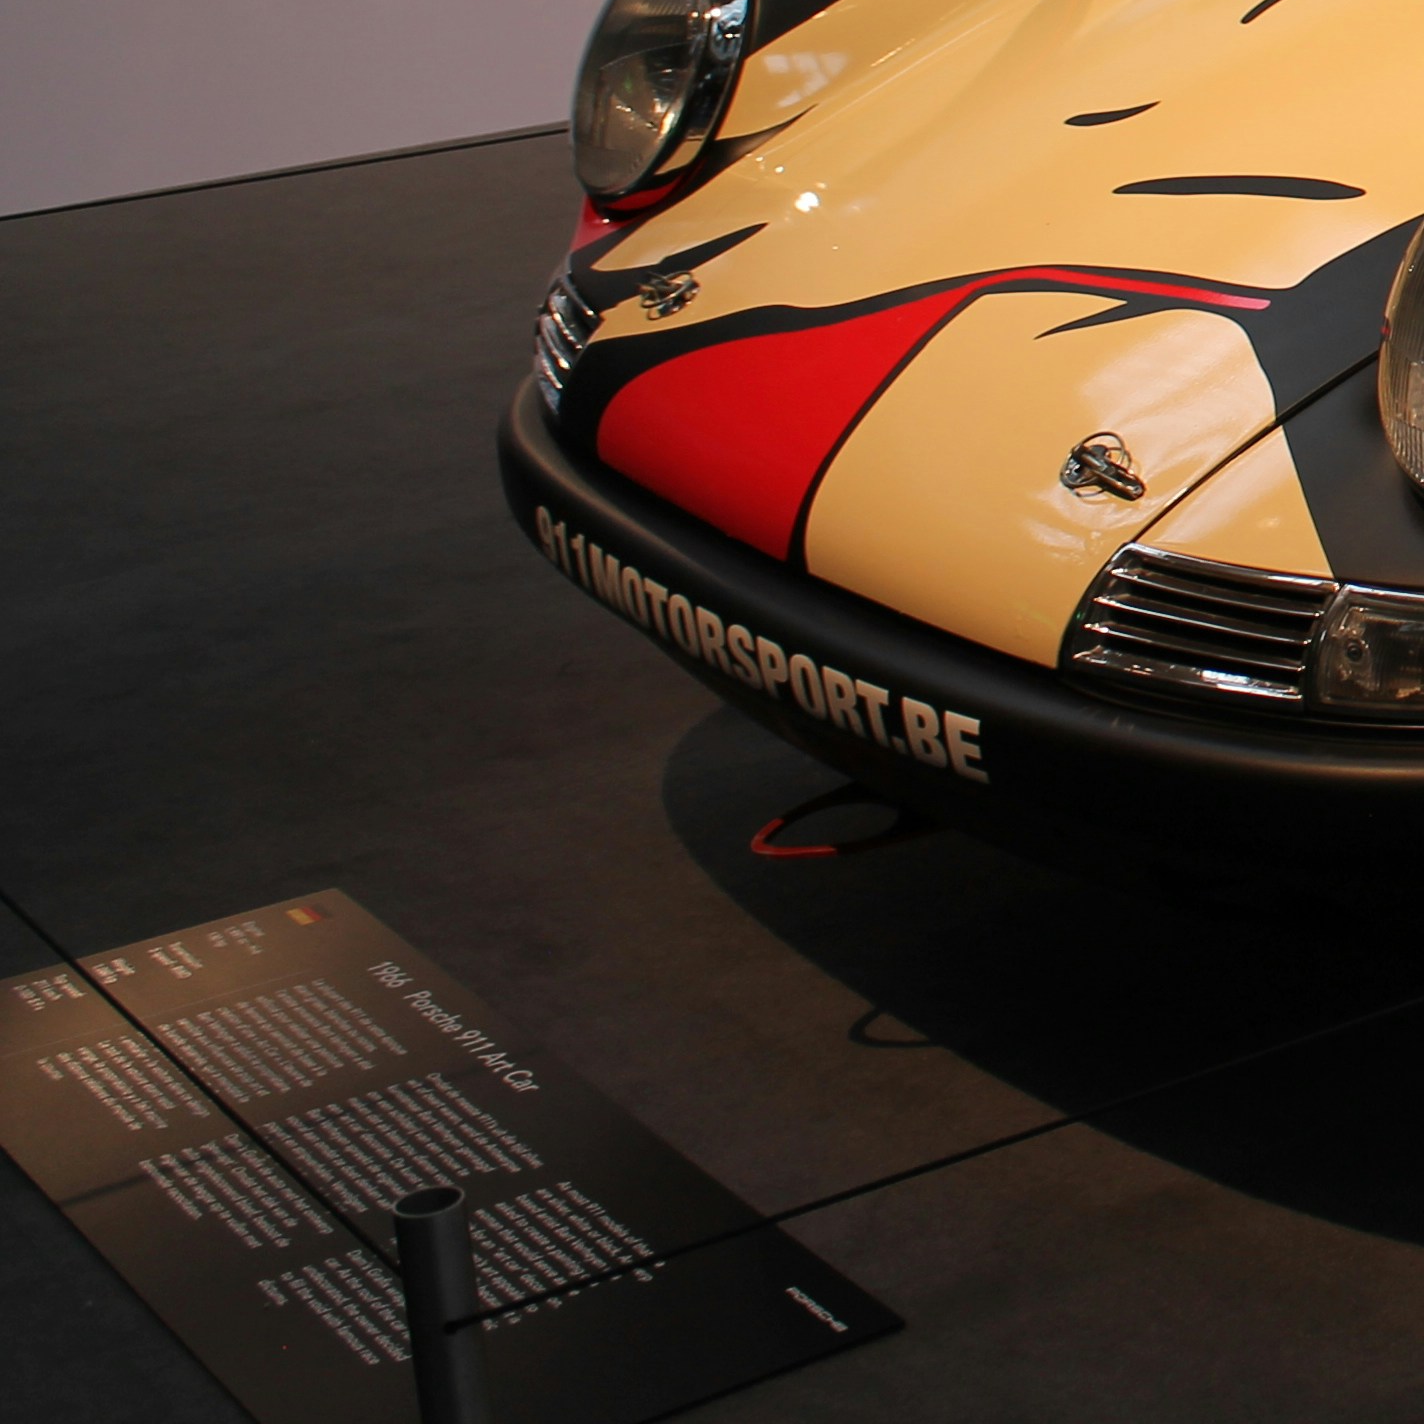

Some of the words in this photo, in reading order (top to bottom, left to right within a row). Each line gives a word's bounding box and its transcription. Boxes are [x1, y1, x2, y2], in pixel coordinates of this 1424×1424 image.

[535, 505, 992, 784] 911MOTORSPORT.BE
[367, 961, 413, 988] 1966
[403, 990, 463, 1033] Porsche
[453, 1030, 495, 1053] 911
[477, 1052, 515, 1073] Art
[503, 1070, 539, 1092] Car
